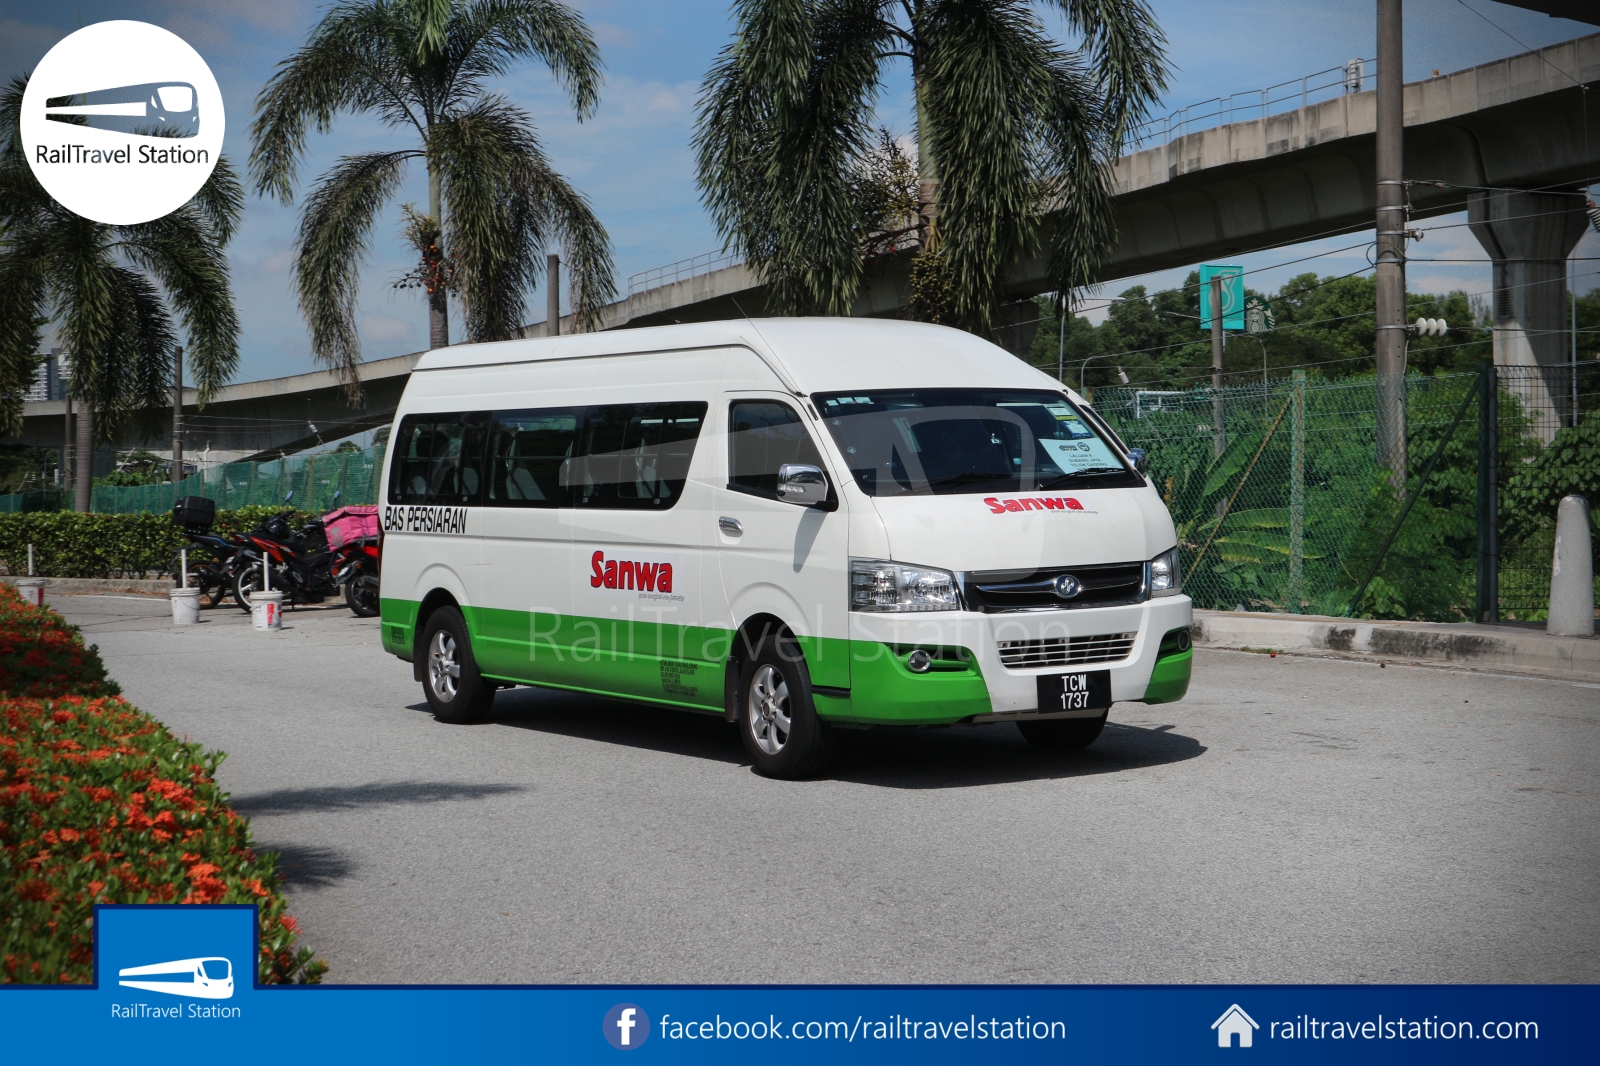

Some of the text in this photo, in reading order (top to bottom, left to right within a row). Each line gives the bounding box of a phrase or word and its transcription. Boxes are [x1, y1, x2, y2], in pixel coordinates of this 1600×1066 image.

[984, 497, 1085, 515] Sanwa
[384, 506, 468, 534] BAS PERSIARAN
[591, 550, 673, 593] Sanwa
[1061, 674, 1087, 692] TCW
[1060, 691, 1089, 710] 1737
